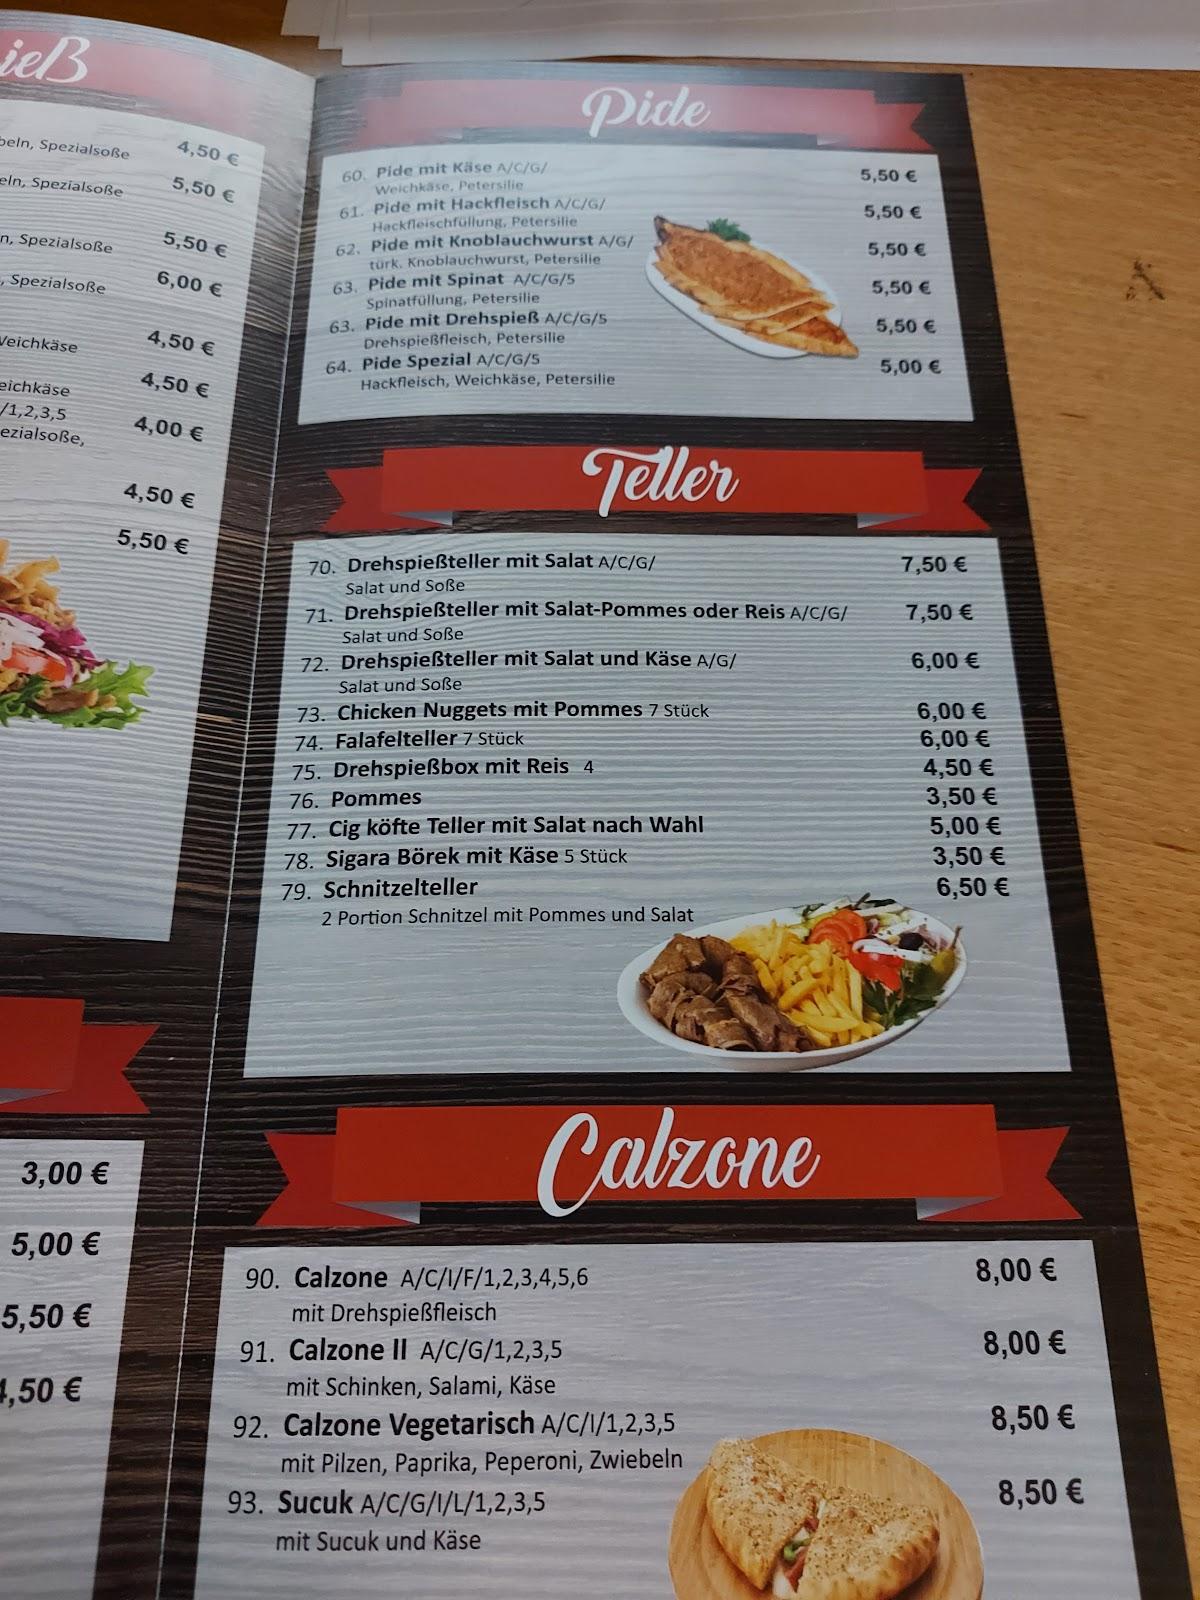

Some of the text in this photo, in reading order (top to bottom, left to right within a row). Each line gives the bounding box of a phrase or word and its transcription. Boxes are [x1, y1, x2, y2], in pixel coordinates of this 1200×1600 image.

[582, 86, 711, 138] Pide
[40, 140, 129, 159] Spezialsoße
[342, 161, 547, 182] 60. Pide mit Käse A/C/G/
[32, 177, 123, 197] Spezialsoße
[375, 180, 523, 195] Weichkäse, Petersilie
[340, 197, 605, 219] 61. Pide mit Hackfleisch A/C/G/
[373, 216, 577, 232] Hackfleischfüllung, Petersilie
[19, 234, 112, 253] Spezialsoße
[336, 234, 633, 256] 62. Pide mit Knoblauchwurst A/G/
[370, 253, 600, 270] türk. Knoblauchwurst, Petersilie
[10, 274, 105, 294] Spezialsoße
[158, 271, 222, 297] 6,00 €
[333, 273, 575, 295] 63. Pide mit Spinat A/C/G/5
[367, 292, 539, 311] Spinatfüllung, Petersilie
[329, 311, 607, 333] 63. Pide mit Drehspieß A/C/G/5
[364, 332, 565, 349] Drehspießfleisch, Petersilie
[326, 352, 539, 374] 64. Pide Spezial A/C/G/5
[881, 359, 941, 376] 5,00 €
[361, 373, 615, 390] Hackfleisch, Weichkäse, Petersilie
[582, 446, 740, 518] Teller
[309, 553, 655, 575] 70. Drehspießteller mit Salat A/C/G/
[901, 556, 967, 575] 7,50 €
[346, 579, 464, 595] Salat und Soße
[306, 601, 847, 623] 71. Drehspießteller mit Salat-Pommes oder Reis A/C/G/
[301, 650, 736, 672] 72. Drehspießteller mit Salat und Käse A/G/
[298, 701, 709, 723] 73. Chicken Nuggets mit Pommes 7 Stück
[292, 758, 594, 781] 75. Drehspießbox mit Reis 4
[924, 759, 994, 779] 4,50 €
[290, 791, 421, 809] 76. Pommes
[287, 816, 703, 840] 77. Cig köfte Teller mit Salat nach Wahl
[284, 846, 627, 871] 78. Sigara Börek mit Käse 5 Stück
[282, 877, 478, 901] 79. Schnitzelteller
[937, 877, 1009, 900] 6,50 €
[322, 907, 694, 926] 2 Portion Schnitzel mit Pommes und Salat
[537, 1106, 821, 1218] Calzone
[12, 1232, 100, 1260] 5,00 €
[246, 1265, 588, 1291] 90. Calzone A/C/I/F/1,2,3,4,5,6
[293, 1302, 496, 1326] mit Drehspießfleisch
[240, 1337, 561, 1363] 91. Calzone II A/C/G/1,2,3,5
[287, 1375, 555, 1399] mit Schinken, Salami, Käse
[234, 1410, 674, 1441] 92. Calzone Vegetarisch A/C/I/1,2,3,5
[992, 1404, 1075, 1435] 8,50 €
[282, 1448, 682, 1477] mit Pilzen, Paprika, Peperoni, Zwiebeln
[228, 1489, 545, 1517] 93. Sucuk A/C/G/I/L/1,2,3,5
